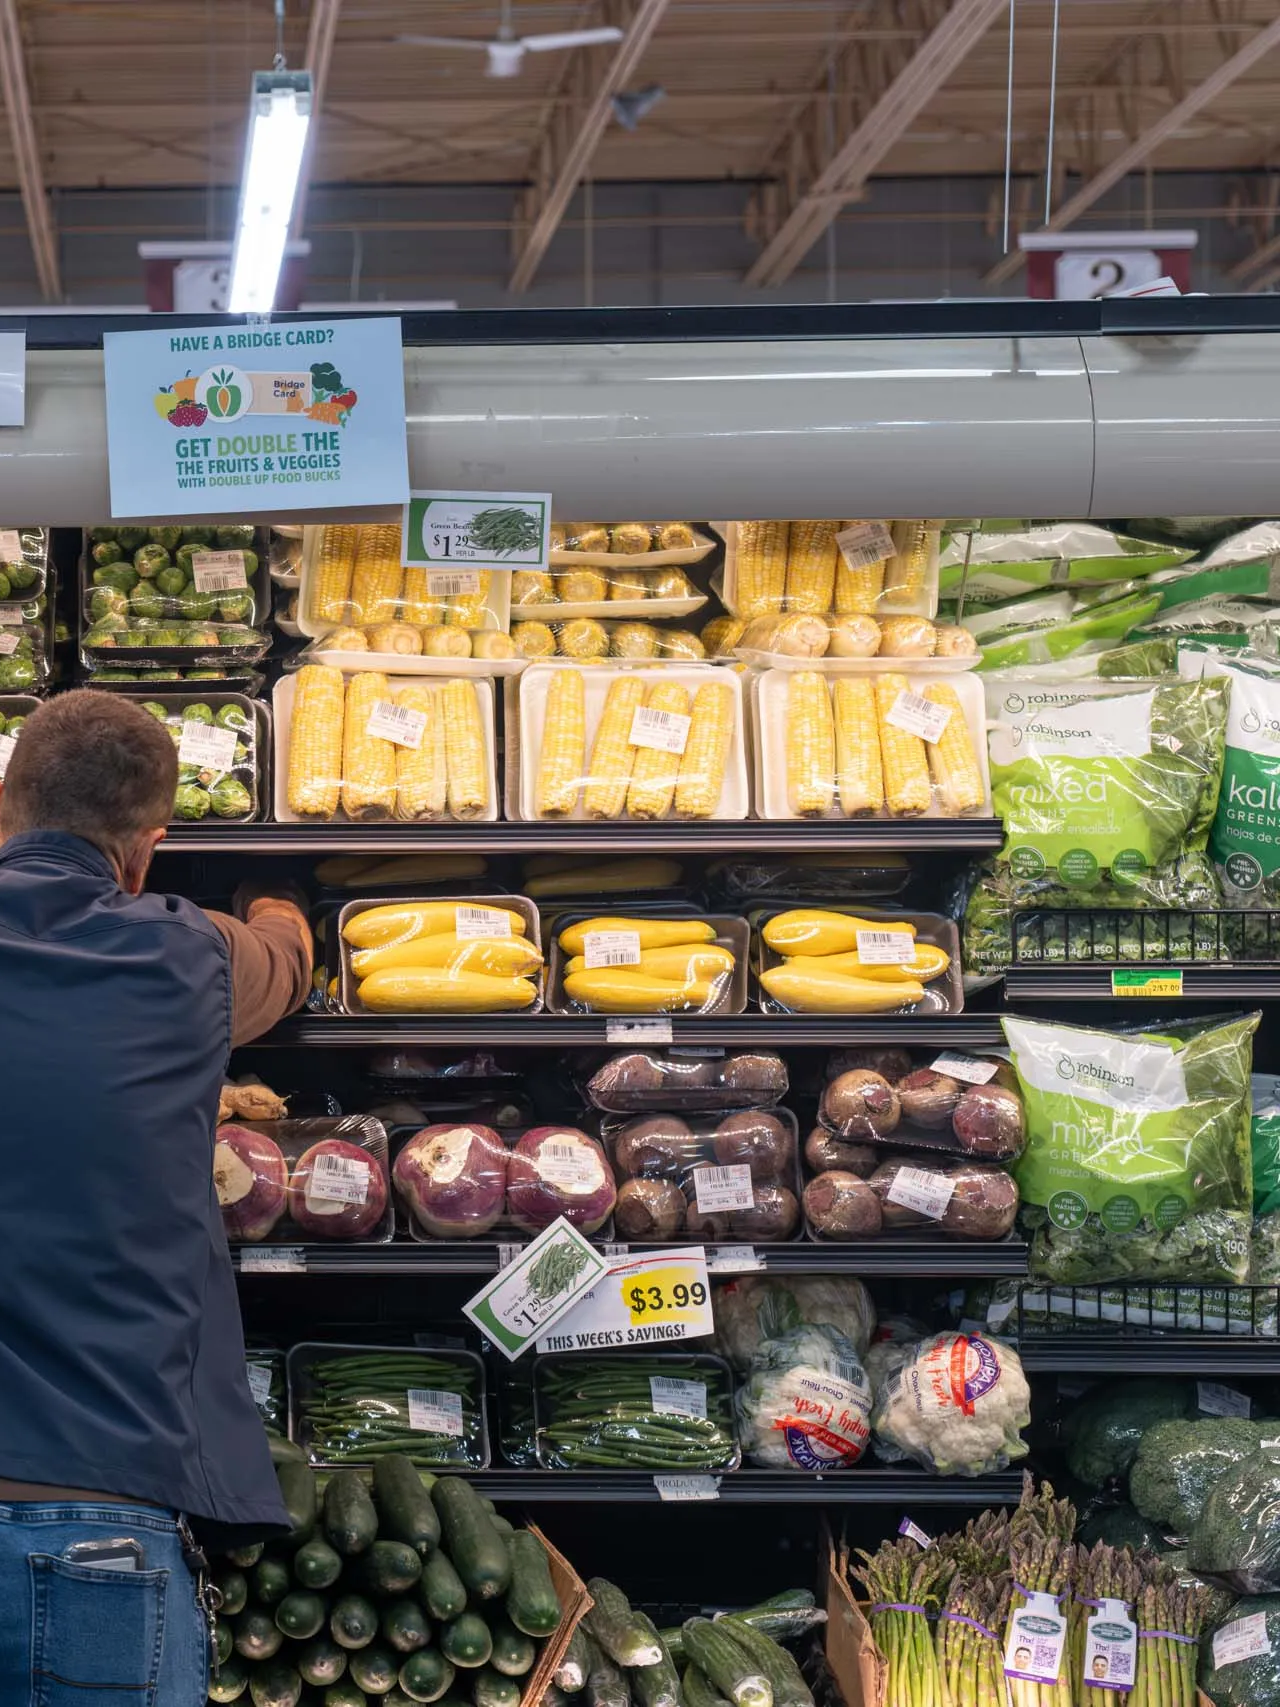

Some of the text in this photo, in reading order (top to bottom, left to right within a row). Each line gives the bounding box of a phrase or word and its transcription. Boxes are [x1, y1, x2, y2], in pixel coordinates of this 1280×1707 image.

[1090, 259, 1125, 299] 2
[170, 329, 334, 352] HAVE A BRIDGE CARD?
[273, 379, 306, 391] Bridge
[273, 389, 297, 398] Card
[175, 431, 340, 459] GET DOUBLE THE
[176, 453, 341, 476] THE FRUITS & VEGGIES
[177, 470, 341, 489] WITH DOUBLE UP FOOD BUCKS
[430, 522, 451, 530] Green
[1025, 723, 1092, 738] robinson
[1009, 773, 1107, 805] mixed
[1077, 1061, 1135, 1088] robinson
[503, 1302, 520, 1317] Green
[630, 1281, 707, 1315] $3.99
[547, 1324, 686, 1351] THIS WEEK'S SAVINGS!
[969, 1341, 997, 1397] BONIPAK
[801, 1378, 844, 1400] Chou-fleur
[793, 1394, 835, 1427] Fresh
